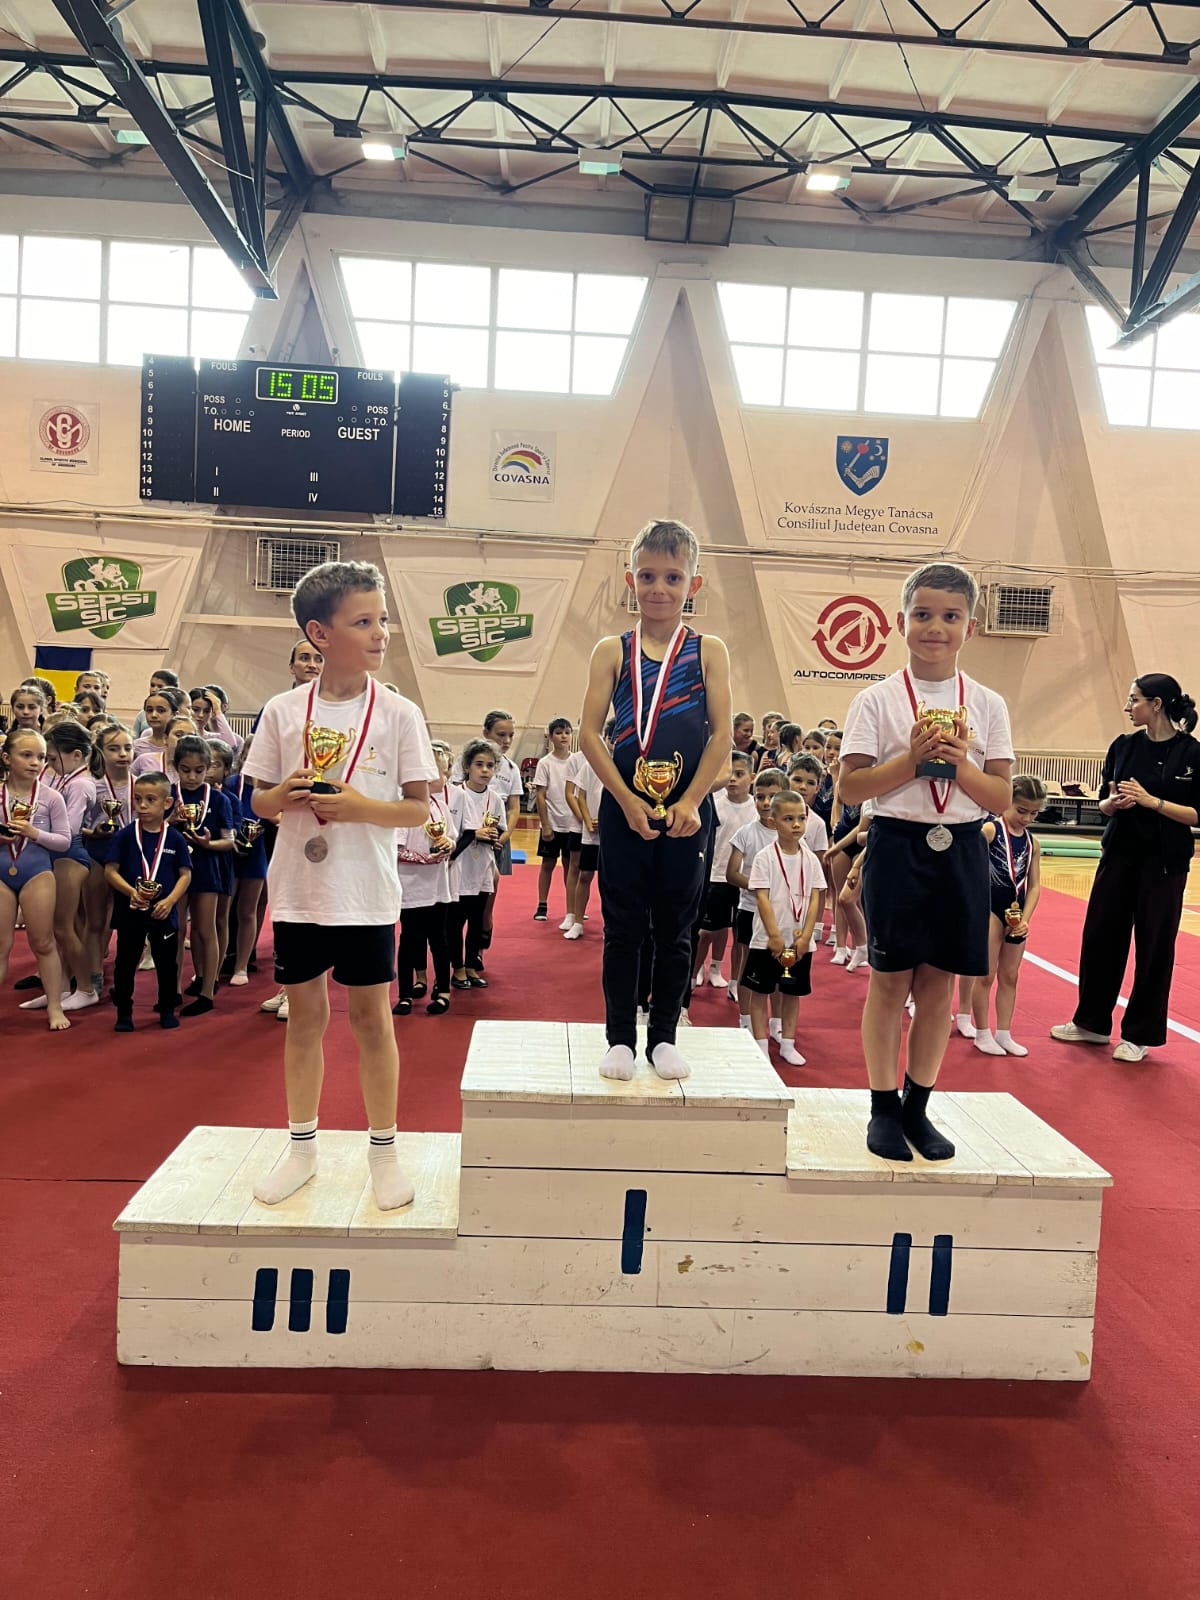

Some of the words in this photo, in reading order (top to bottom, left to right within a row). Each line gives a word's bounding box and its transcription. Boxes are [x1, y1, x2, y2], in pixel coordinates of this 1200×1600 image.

[210, 362, 238, 372] FOULS
[148, 369, 154, 377] 5
[358, 372, 384, 380] FOULS
[148, 381, 154, 389] 6
[270, 372, 292, 397] 15
[301, 374, 334, 400] 05
[443, 390, 448, 398] 5
[204, 394, 226, 404] POSS
[366, 405, 389, 414] POSS
[442, 402, 448, 410] 6
[204, 406, 219, 416] T.O.
[214, 418, 252, 432] HOME
[372, 417, 388, 426] T.O.
[142, 429, 153, 437] 10
[281, 428, 311, 438] PERIOD
[338, 426, 380, 440] GUEST
[142, 452, 152, 460] 12
[435, 448, 446, 456] 10
[142, 464, 152, 472] 13
[142, 476, 152, 484] 14
[309, 472, 319, 482] III
[434, 472, 445, 480] 12
[494, 474, 550, 484] COVASNA
[141, 488, 152, 496] 15
[213, 486, 219, 497] II
[434, 484, 444, 492] 13
[308, 492, 318, 502] IV
[784, 501, 842, 515] Kovászna
[845, 504, 885, 520] Megye
[888, 506, 934, 519] Tanácsa
[777, 516, 830, 530] Consiliul
[833, 519, 885, 534] Județean
[888, 522, 938, 535] Covasna
[886, 1232, 953, 1316] II
[251, 1268, 350, 1335] III
